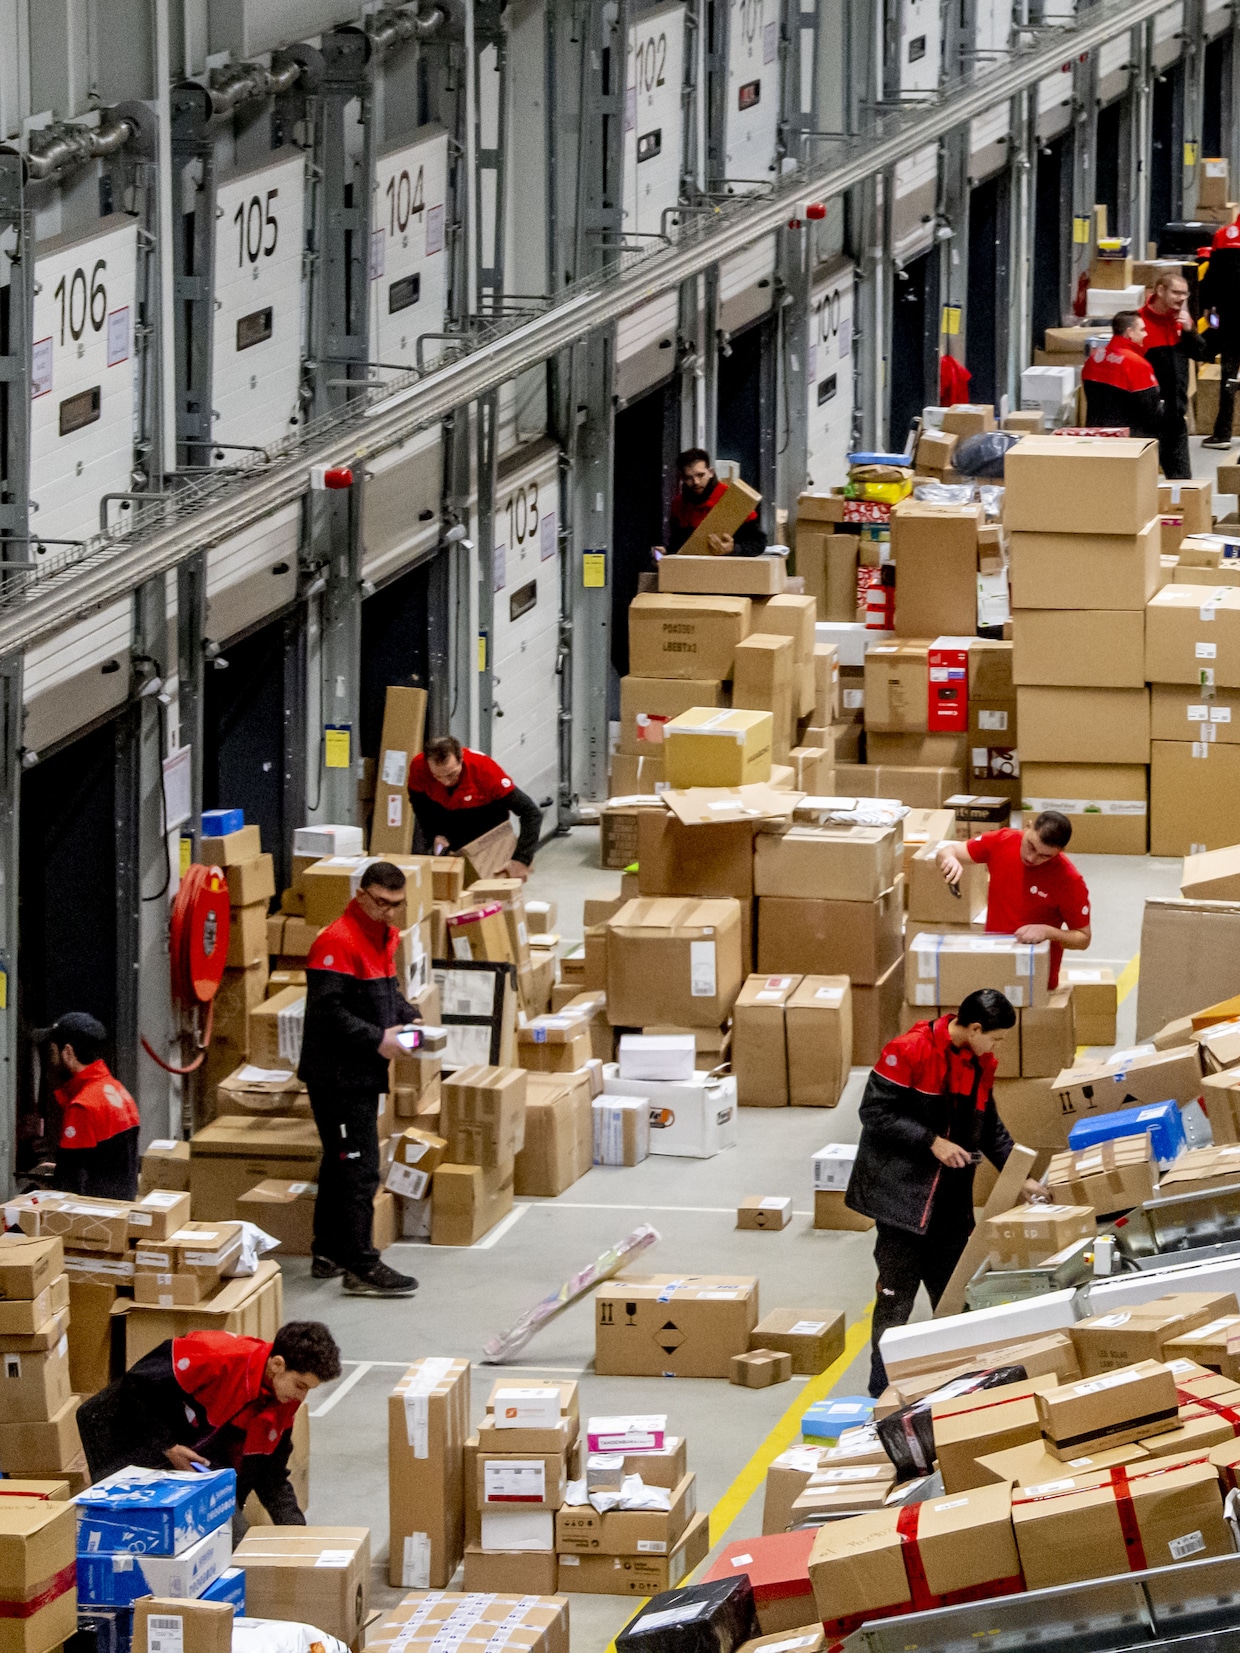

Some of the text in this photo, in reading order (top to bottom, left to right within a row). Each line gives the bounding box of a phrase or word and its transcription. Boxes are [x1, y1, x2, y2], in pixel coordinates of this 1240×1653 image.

[637, 33, 666, 95] 102
[234, 188, 279, 268] 105
[387, 165, 425, 236] 104
[55, 259, 107, 346] 106
[815, 288, 840, 346] 100
[506, 482, 538, 550] 103
